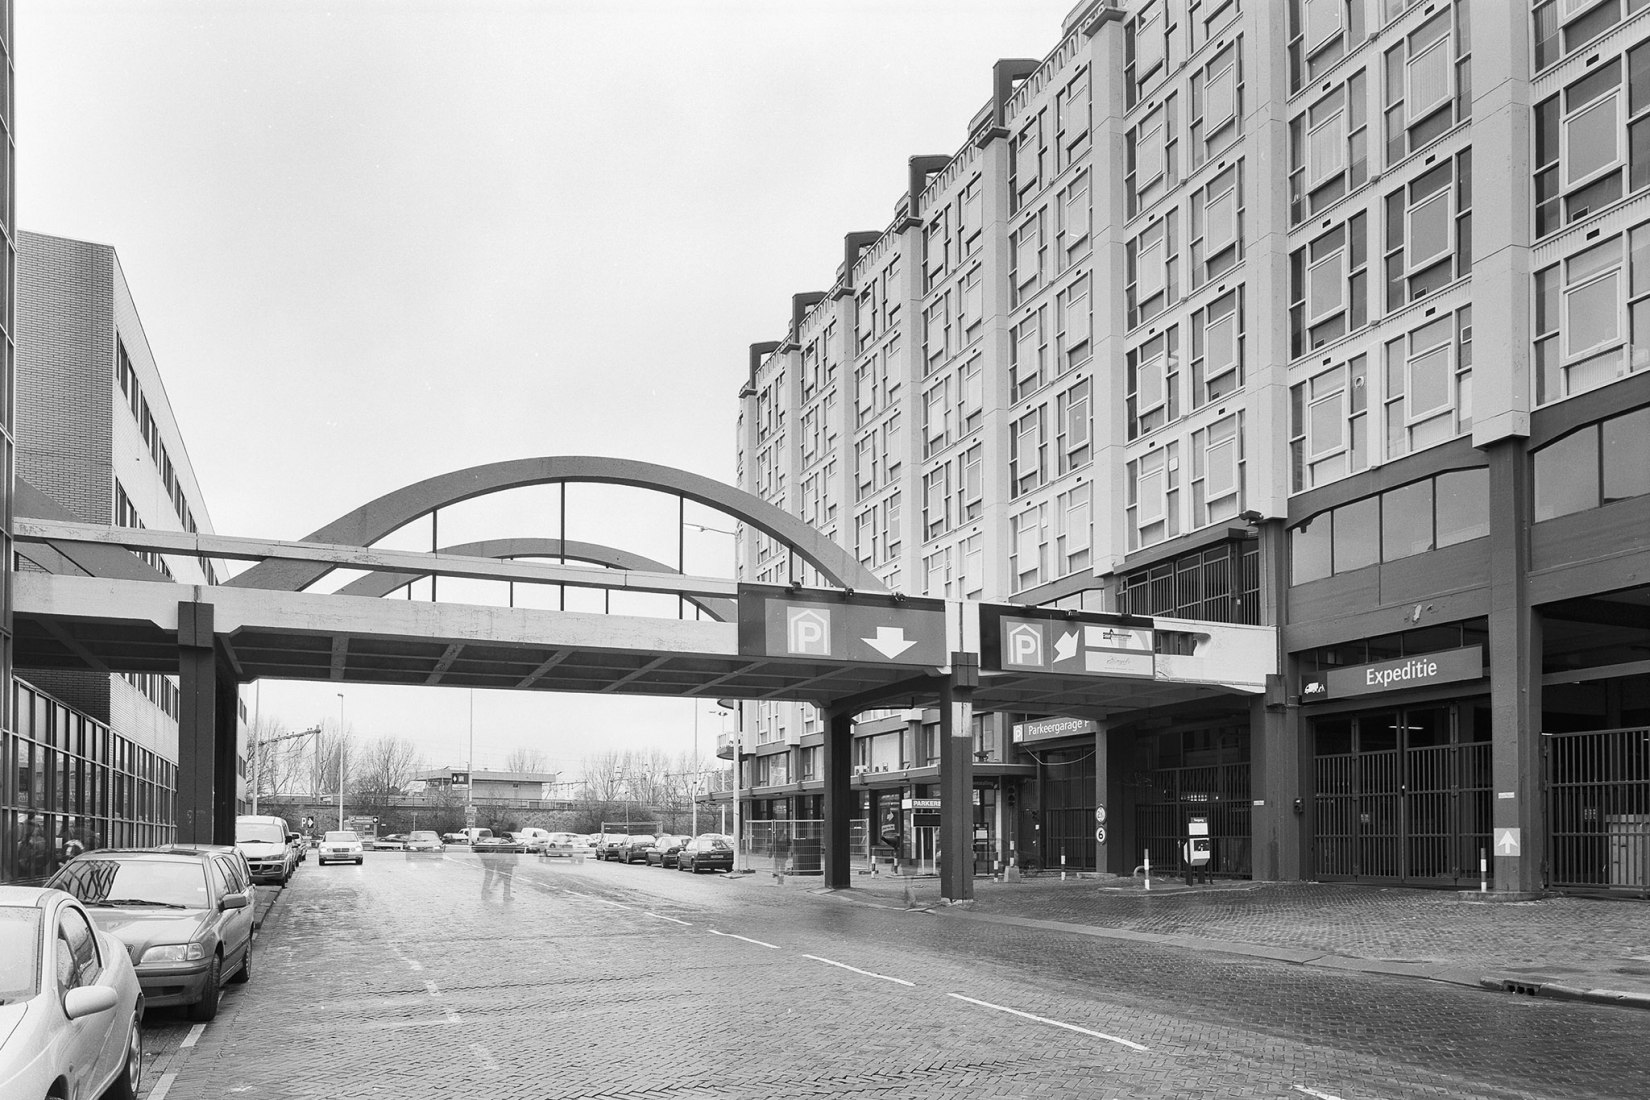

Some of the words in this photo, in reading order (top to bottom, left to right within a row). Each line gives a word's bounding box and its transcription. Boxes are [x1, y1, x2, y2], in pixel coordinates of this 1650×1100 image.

[798, 618, 822, 653] P
[1015, 634, 1036, 664] P
[1367, 658, 1437, 687] Expeditie
[1028, 719, 1083, 736] Parkeergarage
[301, 817, 307, 828] P
[1098, 829, 1104, 840] 6
